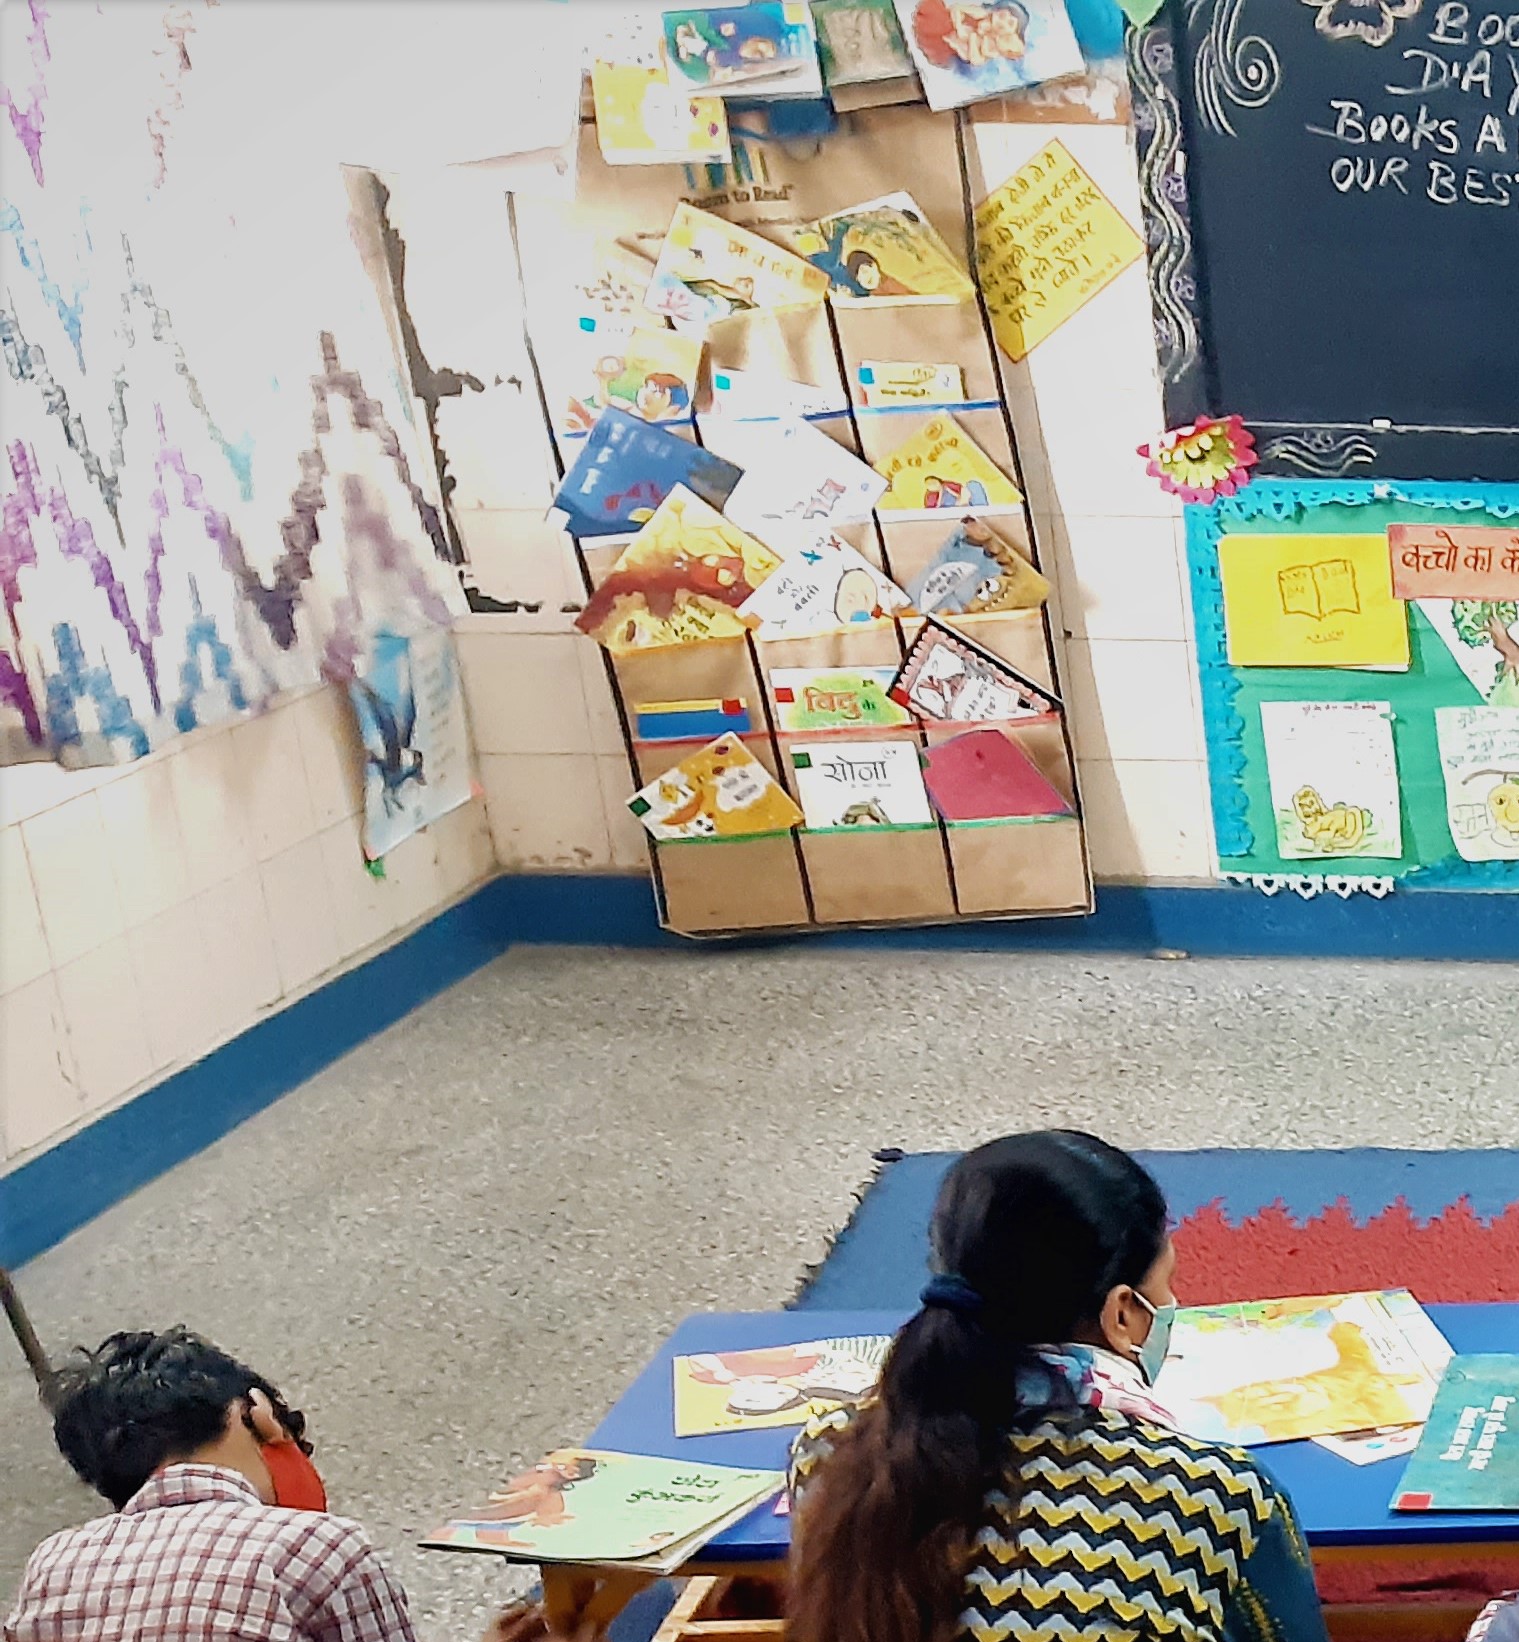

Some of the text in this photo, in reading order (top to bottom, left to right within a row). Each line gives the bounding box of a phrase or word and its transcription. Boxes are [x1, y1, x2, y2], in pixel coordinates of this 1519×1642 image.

[1331, 155, 1407, 196] OUR
[1464, 548, 1492, 574] का
[821, 755, 888, 783] सोना
